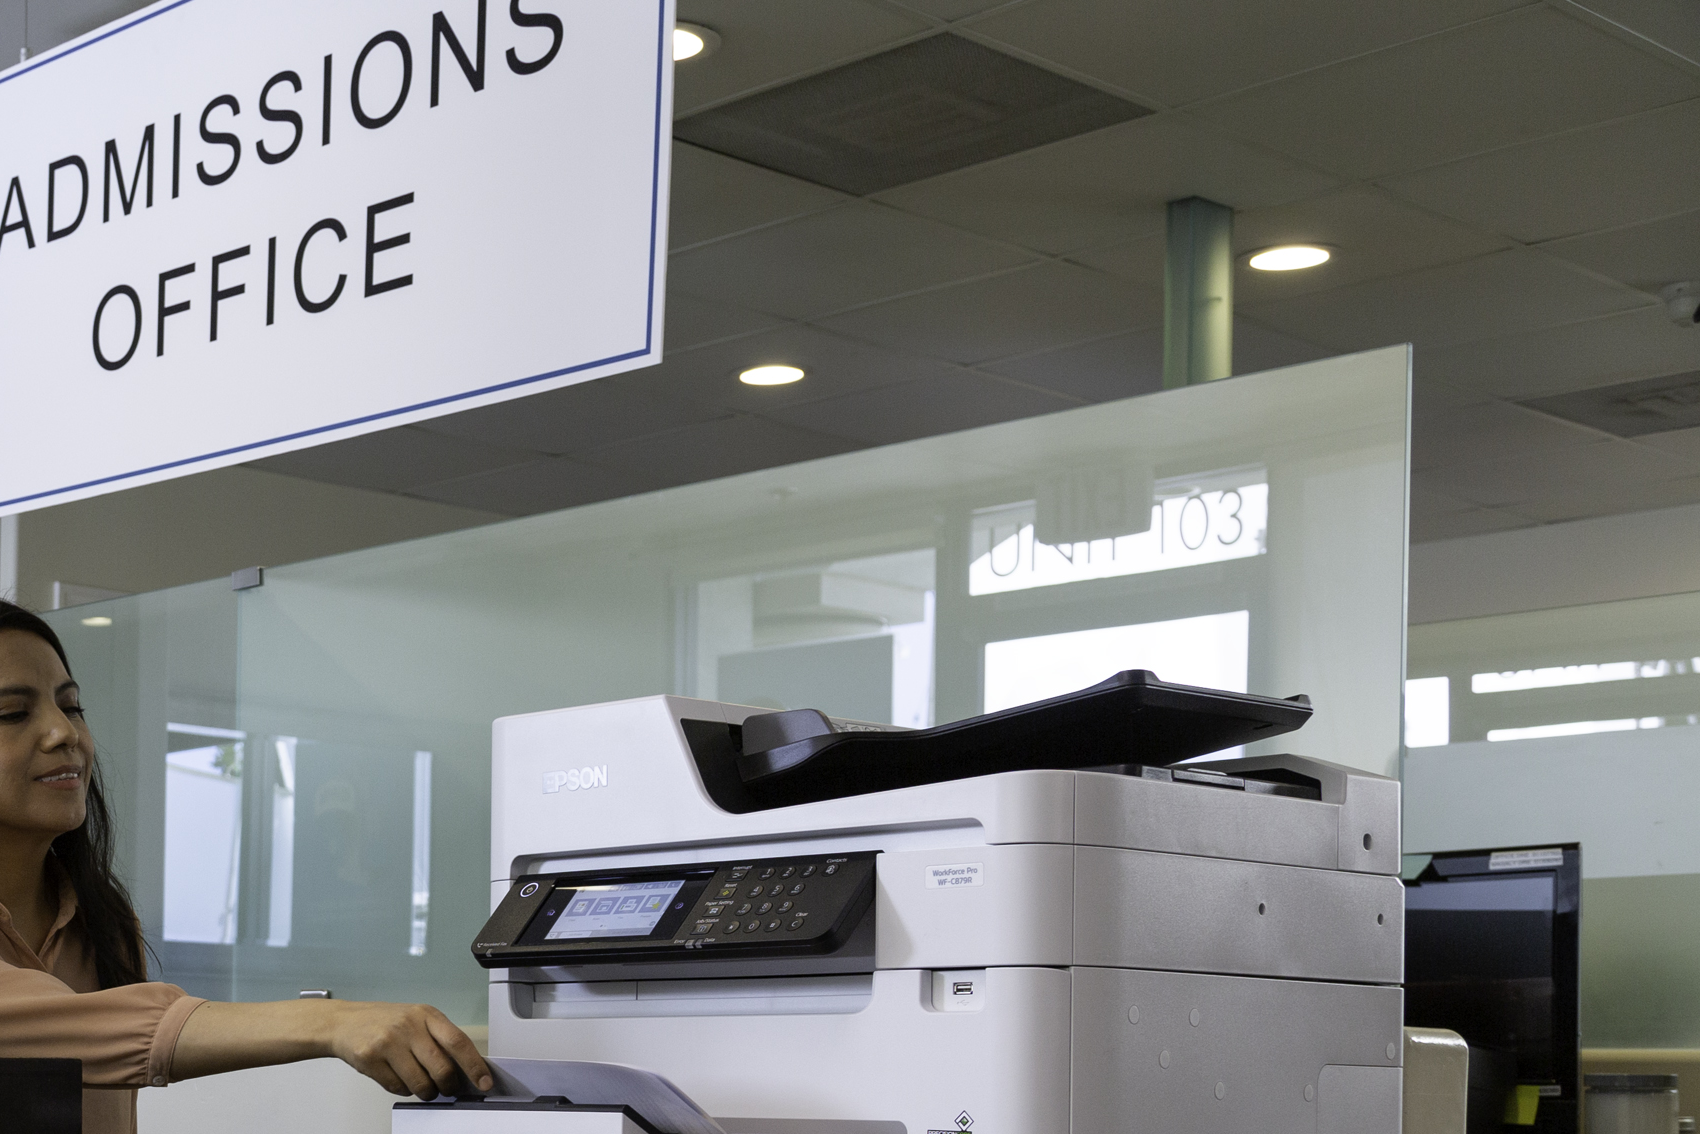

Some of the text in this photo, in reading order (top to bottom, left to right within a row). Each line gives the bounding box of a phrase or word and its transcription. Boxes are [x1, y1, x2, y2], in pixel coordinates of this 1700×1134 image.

[91, 191, 415, 372] OFFICE
[1157, 489, 1244, 554] 103
[541, 764, 609, 794] EPSON
[932, 868, 965, 877] WorkForce
[937, 877, 973, 886] WF-C879R
